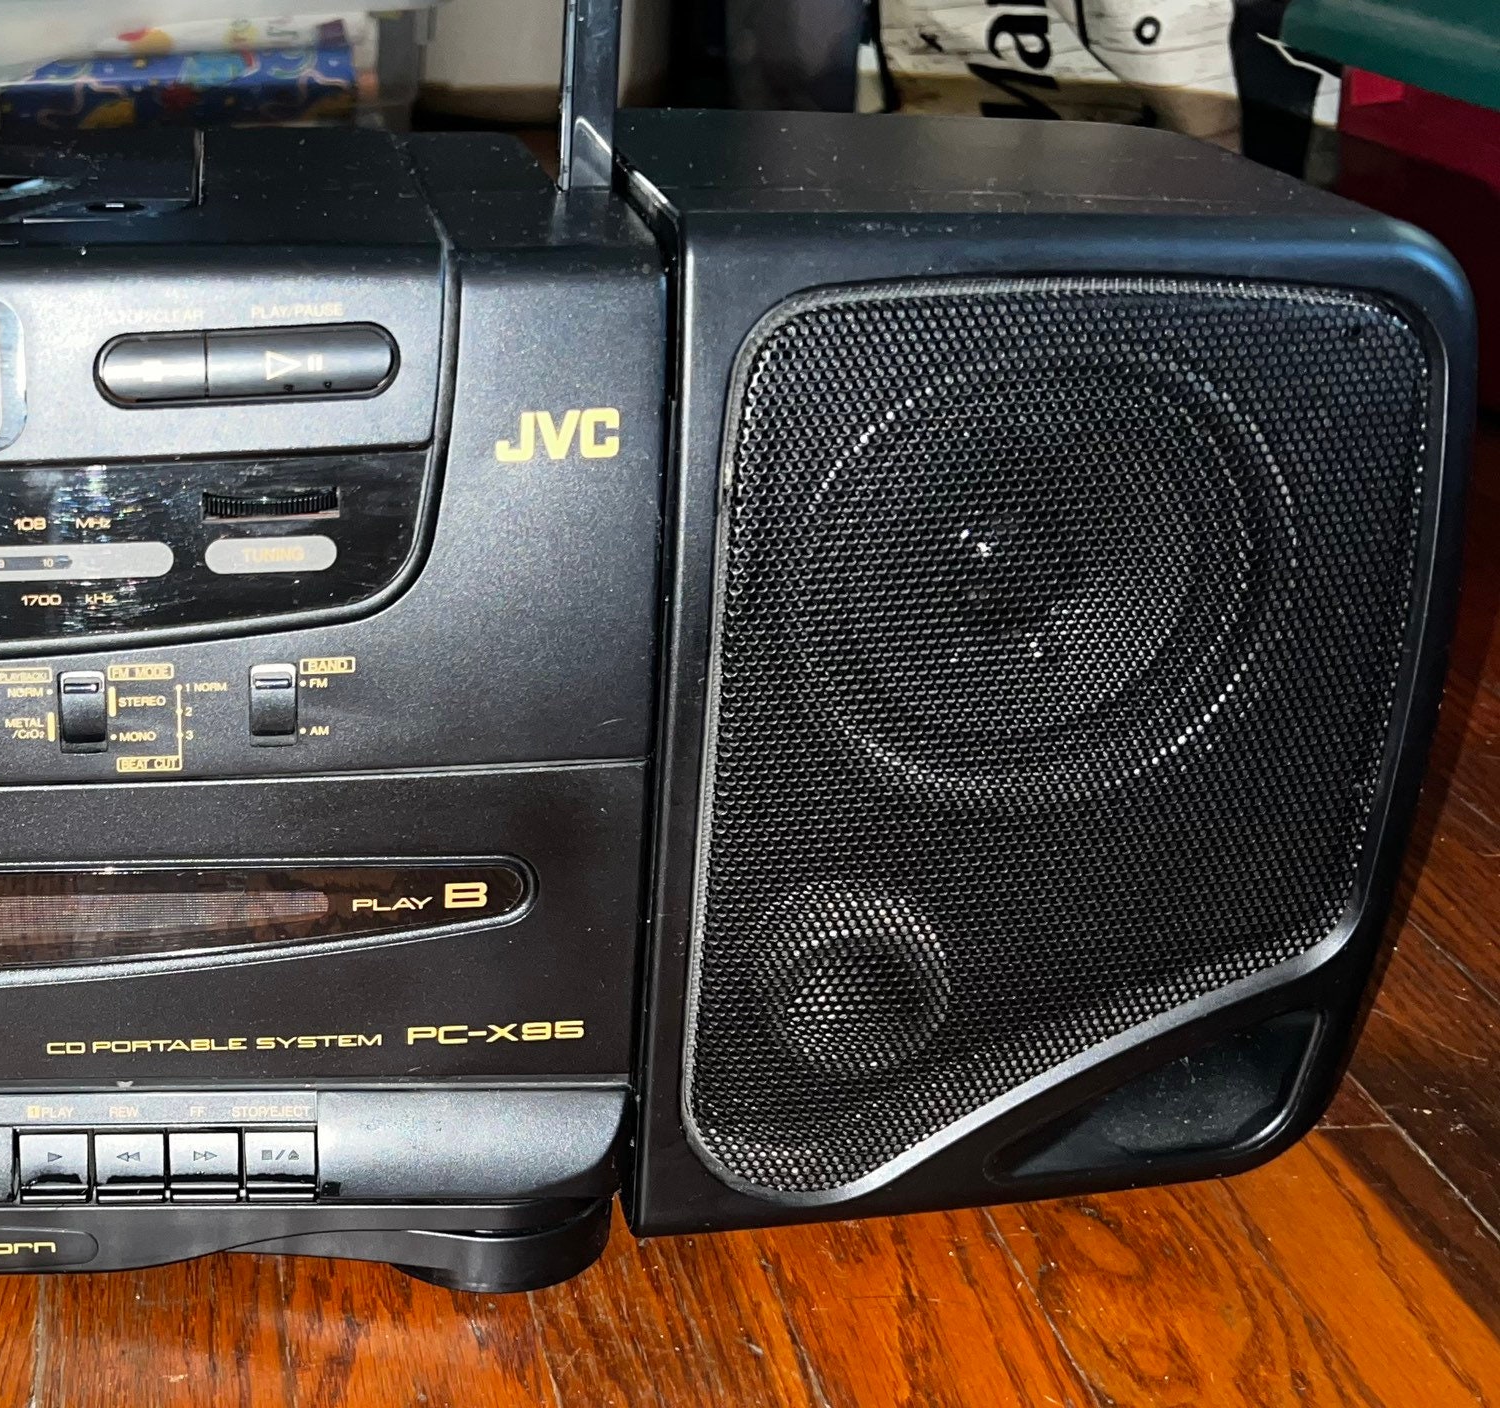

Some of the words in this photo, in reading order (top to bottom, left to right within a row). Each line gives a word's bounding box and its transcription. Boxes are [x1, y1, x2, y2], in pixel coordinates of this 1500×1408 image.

[967, 0, 1061, 120] Ma
[250, 303, 345, 319] PLAY/PAUSE
[495, 407, 621, 462] JVC
[13, 516, 48, 532] 108
[75, 516, 111, 530] MHz
[241, 546, 305, 563] TUNING
[43, 557, 54, 568] 10
[21, 594, 62, 606] 1700
[85, 592, 115, 605] kHz
[308, 659, 348, 672] BAND
[111, 667, 127, 678] FM
[135, 665, 170, 676] MODE
[194, 682, 228, 692] NORM
[309, 678, 328, 688] FM
[7, 687, 44, 697] NORM
[118, 695, 167, 707] STEREO
[186, 707, 193, 717] 2
[5, 718, 44, 728] METAL
[119, 731, 156, 741] MONO
[186, 730, 194, 740] 3
[309, 726, 330, 736] AM
[121, 759, 148, 769] BEAT
[154, 758, 178, 768] CUT
[352, 896, 433, 911] PLAY
[444, 882, 488, 909] B
[46, 1042, 86, 1054] CD
[92, 1037, 247, 1054] PORTABLE
[255, 1034, 383, 1051] SYSTEM
[407, 1020, 585, 1045] PC-X95
[41, 1107, 75, 1118] PLAY
[109, 1106, 139, 1117] REW
[190, 1106, 205, 1117] FF
[232, 1105, 311, 1118] STOP/EJECT
